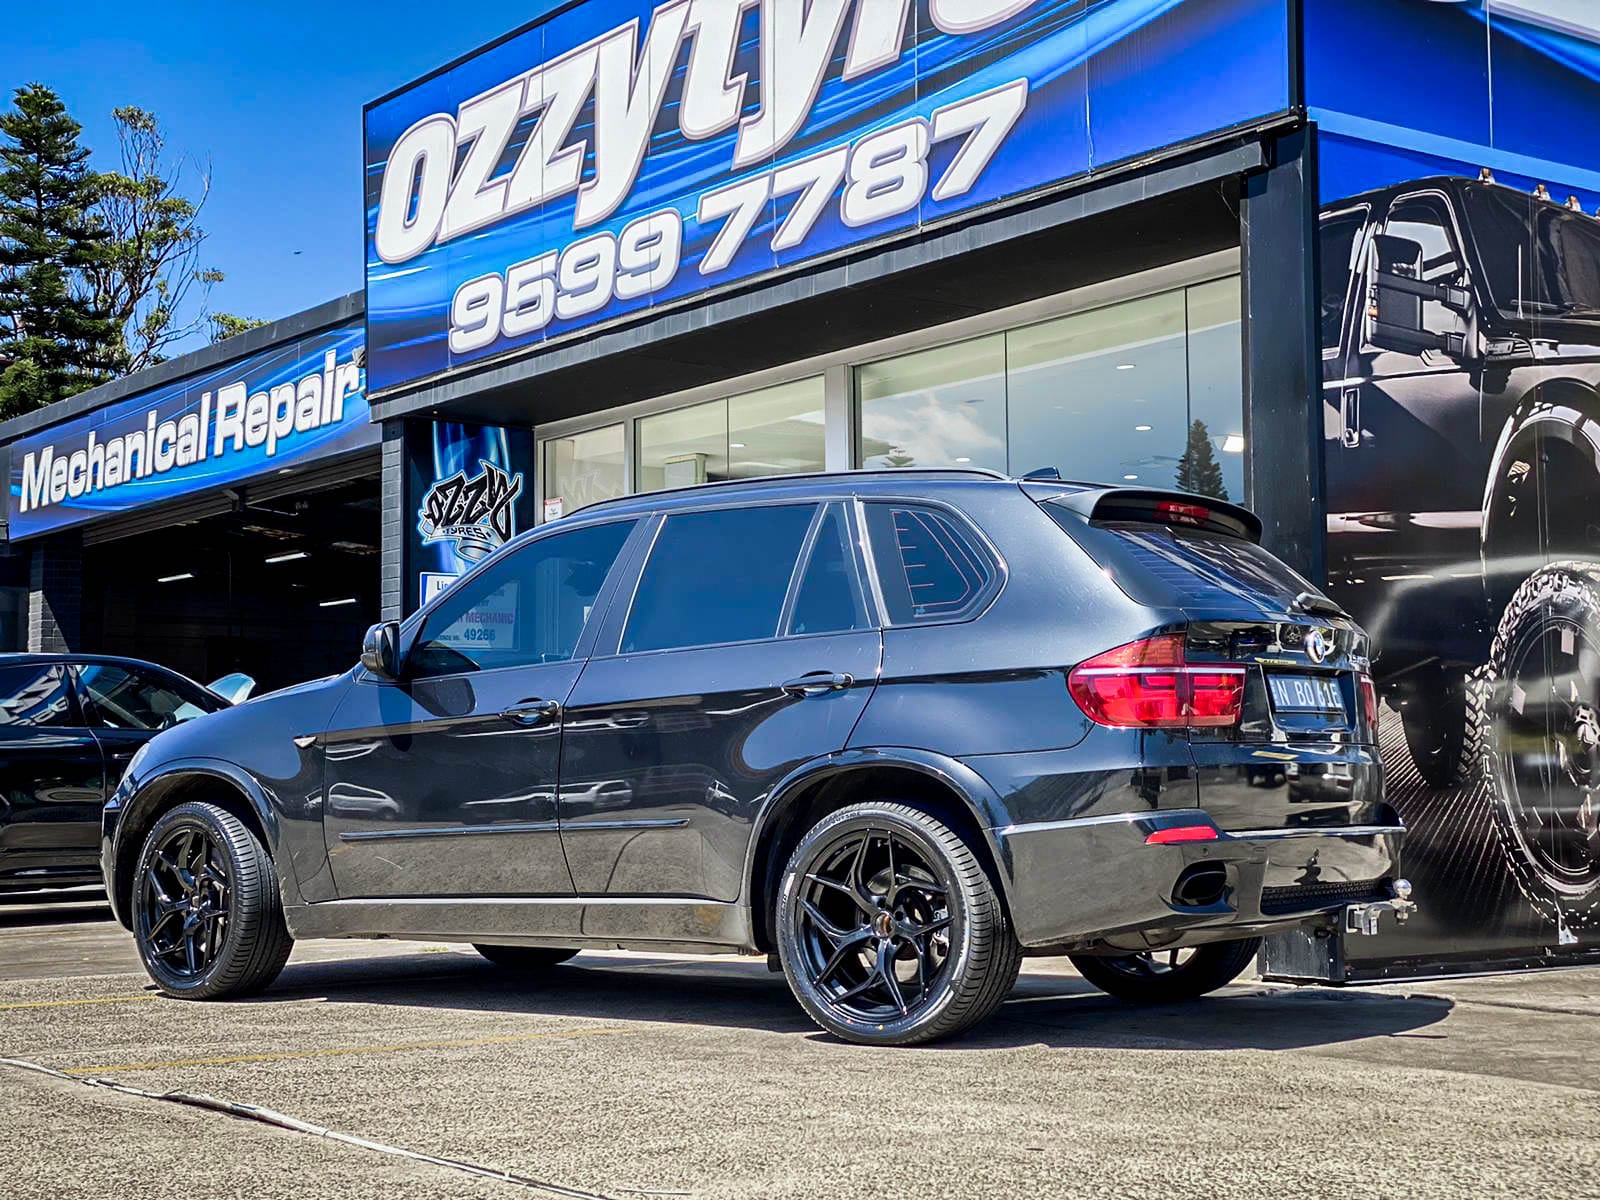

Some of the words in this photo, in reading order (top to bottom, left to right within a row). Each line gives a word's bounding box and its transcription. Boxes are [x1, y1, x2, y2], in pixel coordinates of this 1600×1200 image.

[448, 207, 683, 355] 9599
[698, 77, 1029, 276] 7787
[19, 391, 212, 513] Mechanical
[445, 526, 489, 541] TYRES
